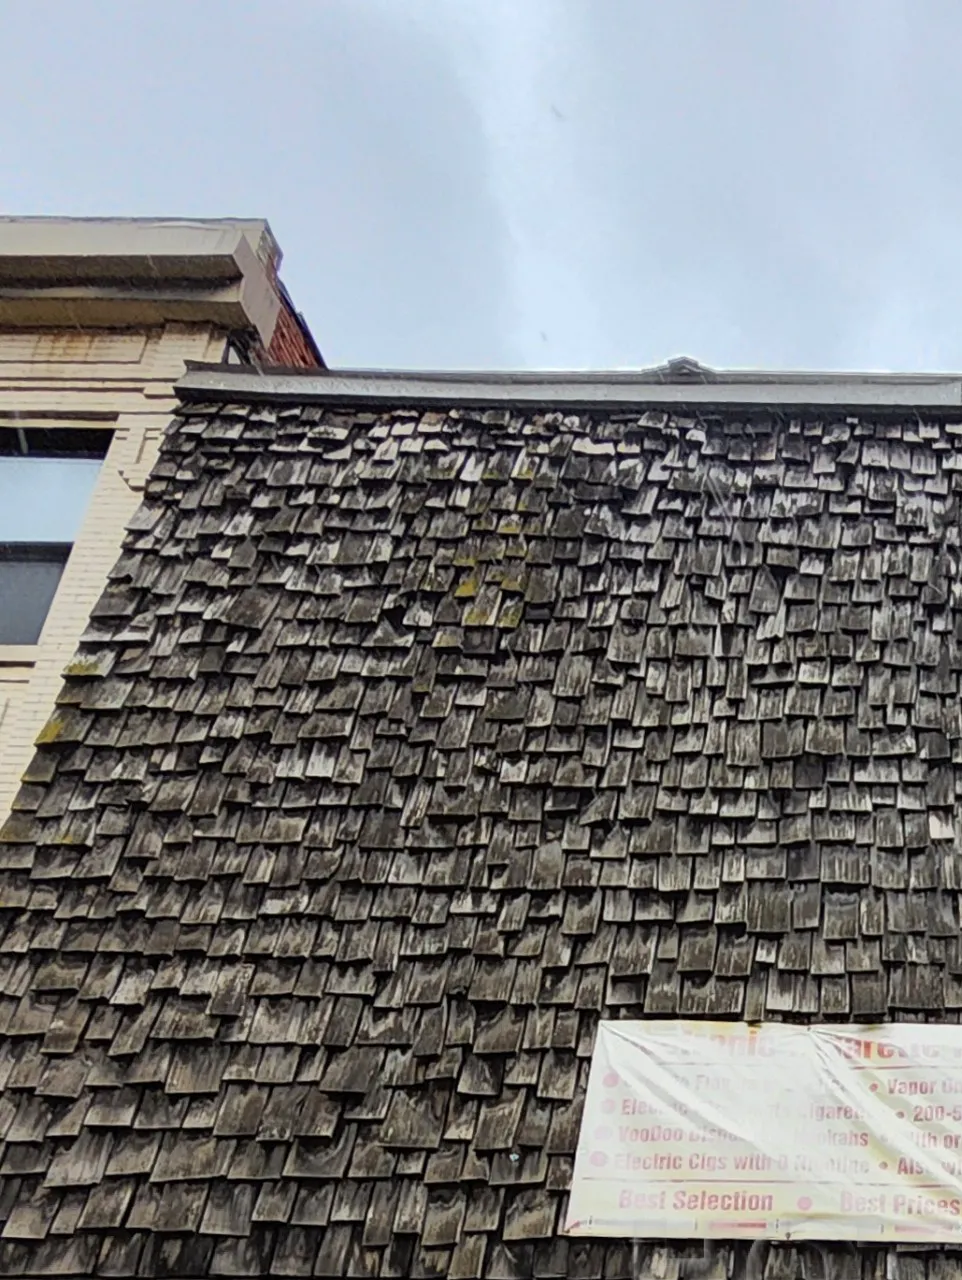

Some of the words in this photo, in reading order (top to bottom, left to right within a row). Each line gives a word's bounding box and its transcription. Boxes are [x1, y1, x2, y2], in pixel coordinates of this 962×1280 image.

[888, 1078, 937, 1096] Vapor
[618, 1125, 683, 1143] VooDoo
[943, 1134, 962, 1149] or
[613, 1152, 683, 1171] Electric
[688, 1153, 728, 1172] Cigs
[733, 1153, 772, 1171] with
[618, 1189, 667, 1210] Best
[672, 1190, 774, 1212] Selection
[841, 1191, 887, 1214] Best
[893, 1193, 961, 1216] Prices
